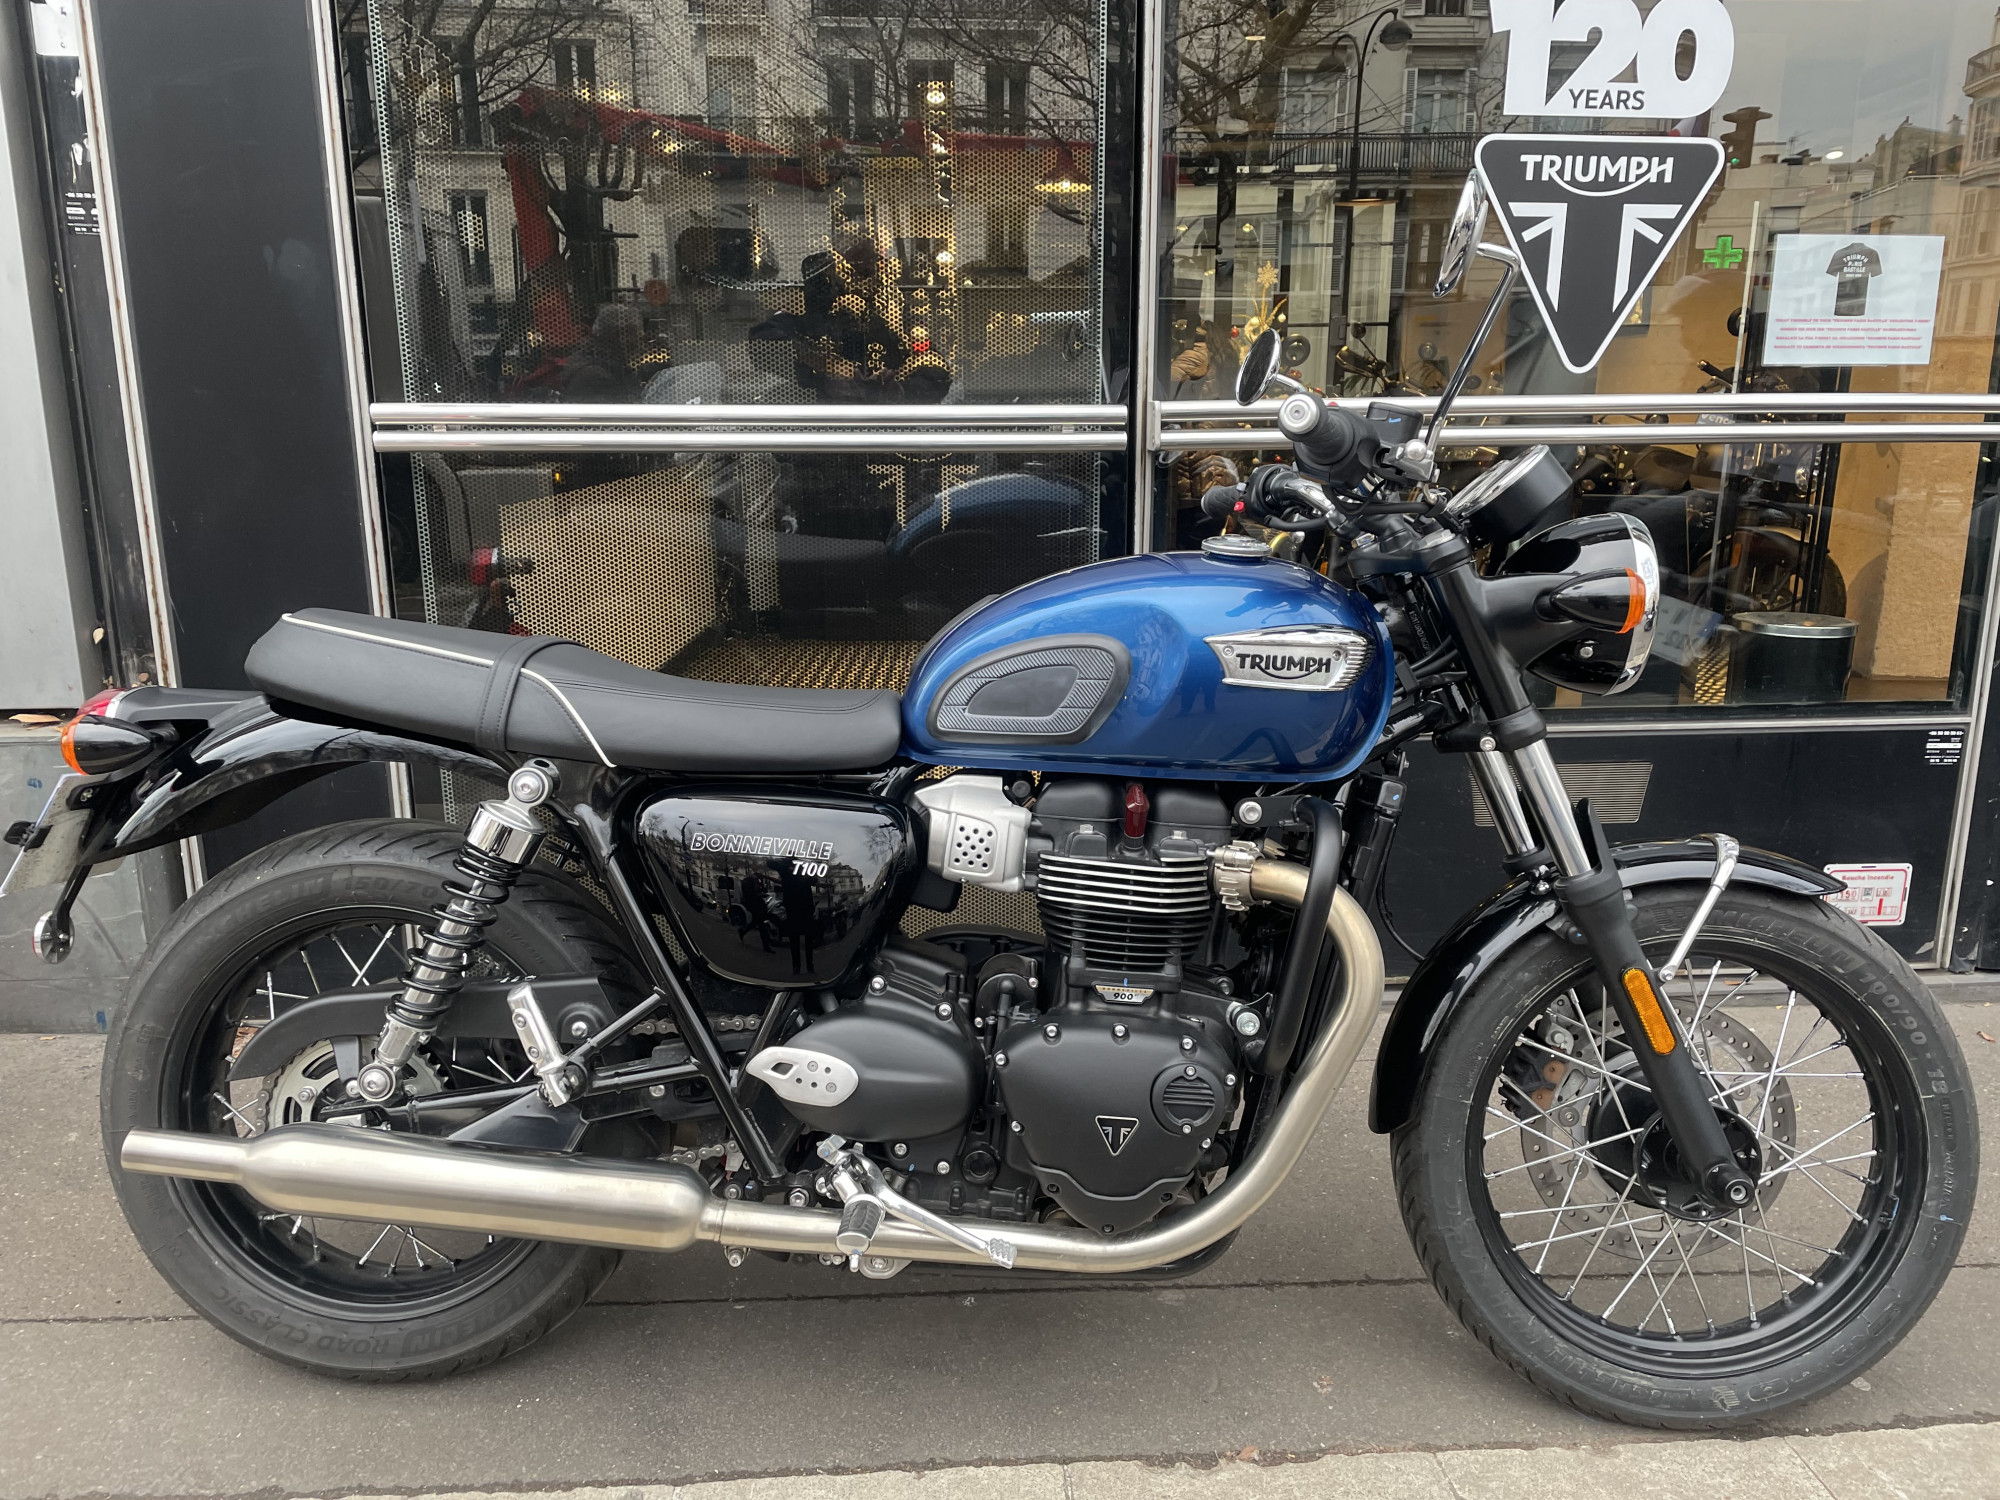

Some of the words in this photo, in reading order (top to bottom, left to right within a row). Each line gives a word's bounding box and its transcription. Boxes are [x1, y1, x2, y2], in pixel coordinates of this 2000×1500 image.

[1489, 0, 1735, 118] 120
[1568, 88, 1646, 111] YEARS
[1519, 154, 1675, 195] TRIUMPH
[1843, 253, 1869, 263] TRIUMPH
[1235, 653, 1332, 679] TRIUMPH
[691, 832, 834, 860] BONNEVILLE
[791, 859, 828, 878] T100
[1113, 992, 1134, 1001] 900
[1858, 971, 1929, 1045] 100/90
[1927, 1067, 1949, 1094] 18
[209, 1285, 310, 1344] CLASSIC
[316, 1334, 391, 1355] ROAD
